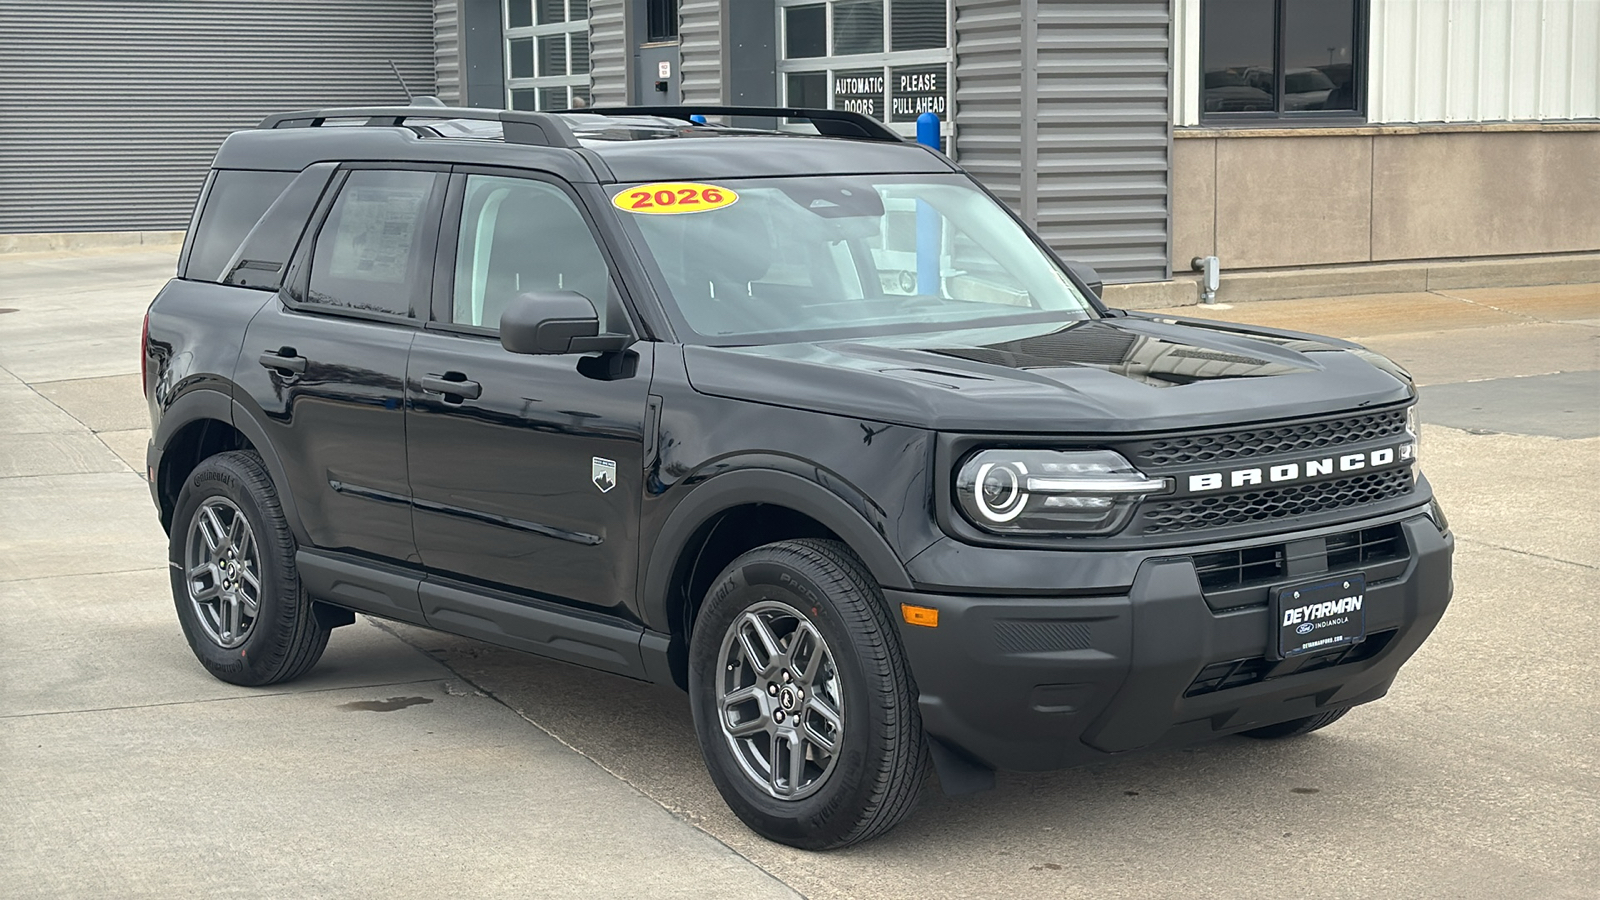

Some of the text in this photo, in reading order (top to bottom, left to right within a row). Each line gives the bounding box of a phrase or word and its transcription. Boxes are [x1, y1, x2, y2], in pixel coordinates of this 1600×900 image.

[835, 77, 884, 94] AUTOMATIC
[901, 74, 937, 92] PLEASE
[844, 99, 874, 115] DOORS
[893, 96, 945, 114] PULL AHEAD
[630, 188, 724, 209] 2026
[1189, 448, 1393, 492] BRONCO
[1283, 595, 1363, 627] DEYARMAN
[1315, 616, 1349, 630] INDIANOLA
